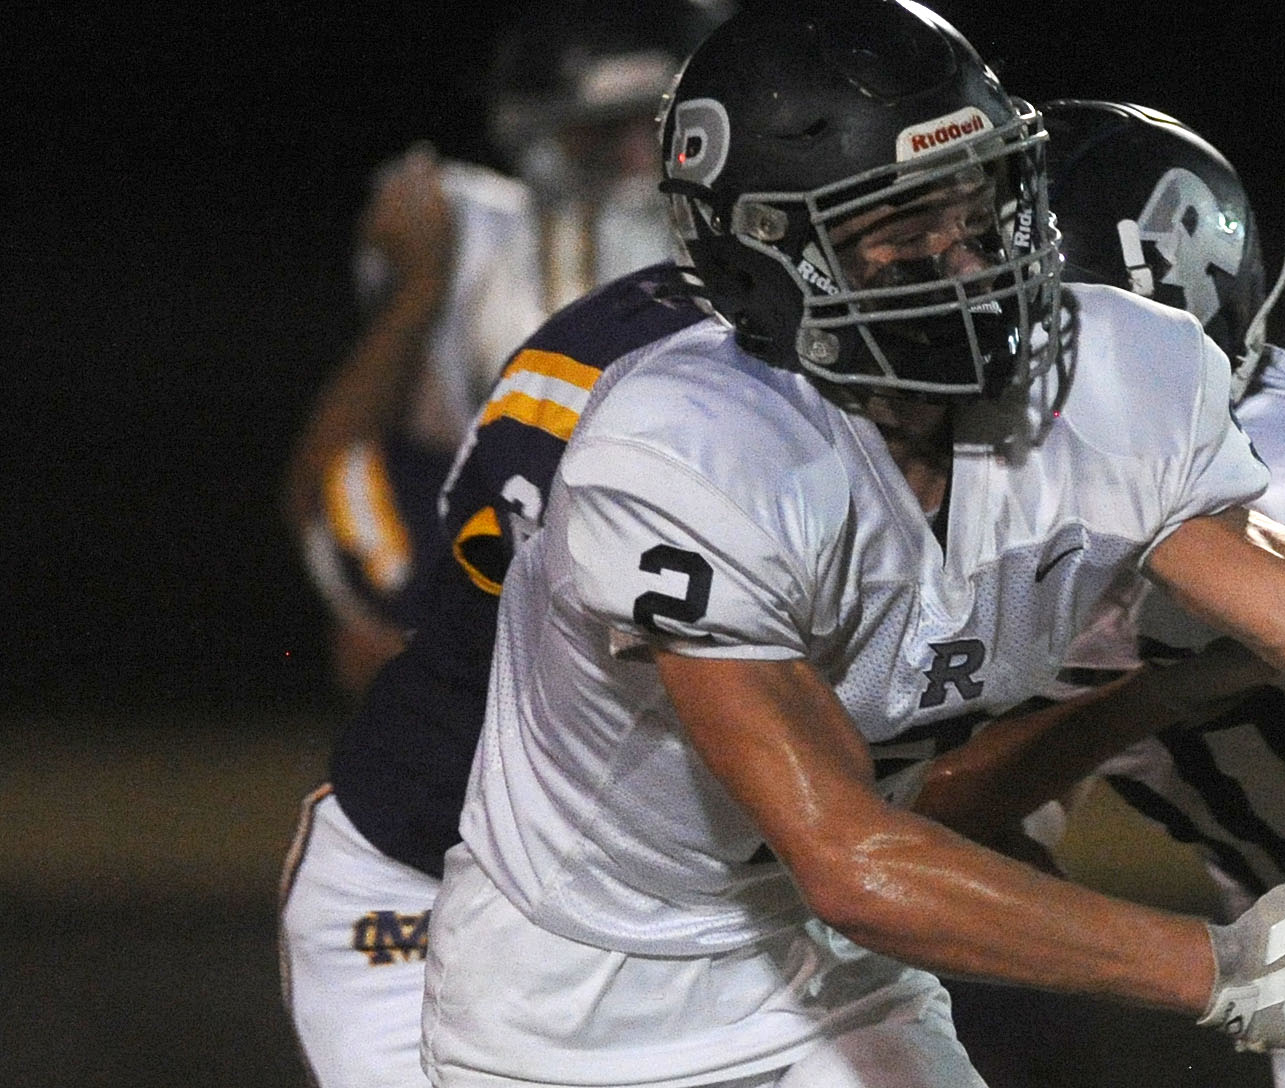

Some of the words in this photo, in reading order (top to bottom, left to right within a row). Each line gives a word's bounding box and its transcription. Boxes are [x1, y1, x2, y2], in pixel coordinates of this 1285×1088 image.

[911, 113, 985, 153] Riddell
[1136, 166, 1246, 327] R
[633, 543, 715, 640] 2
[918, 637, 988, 710] R
